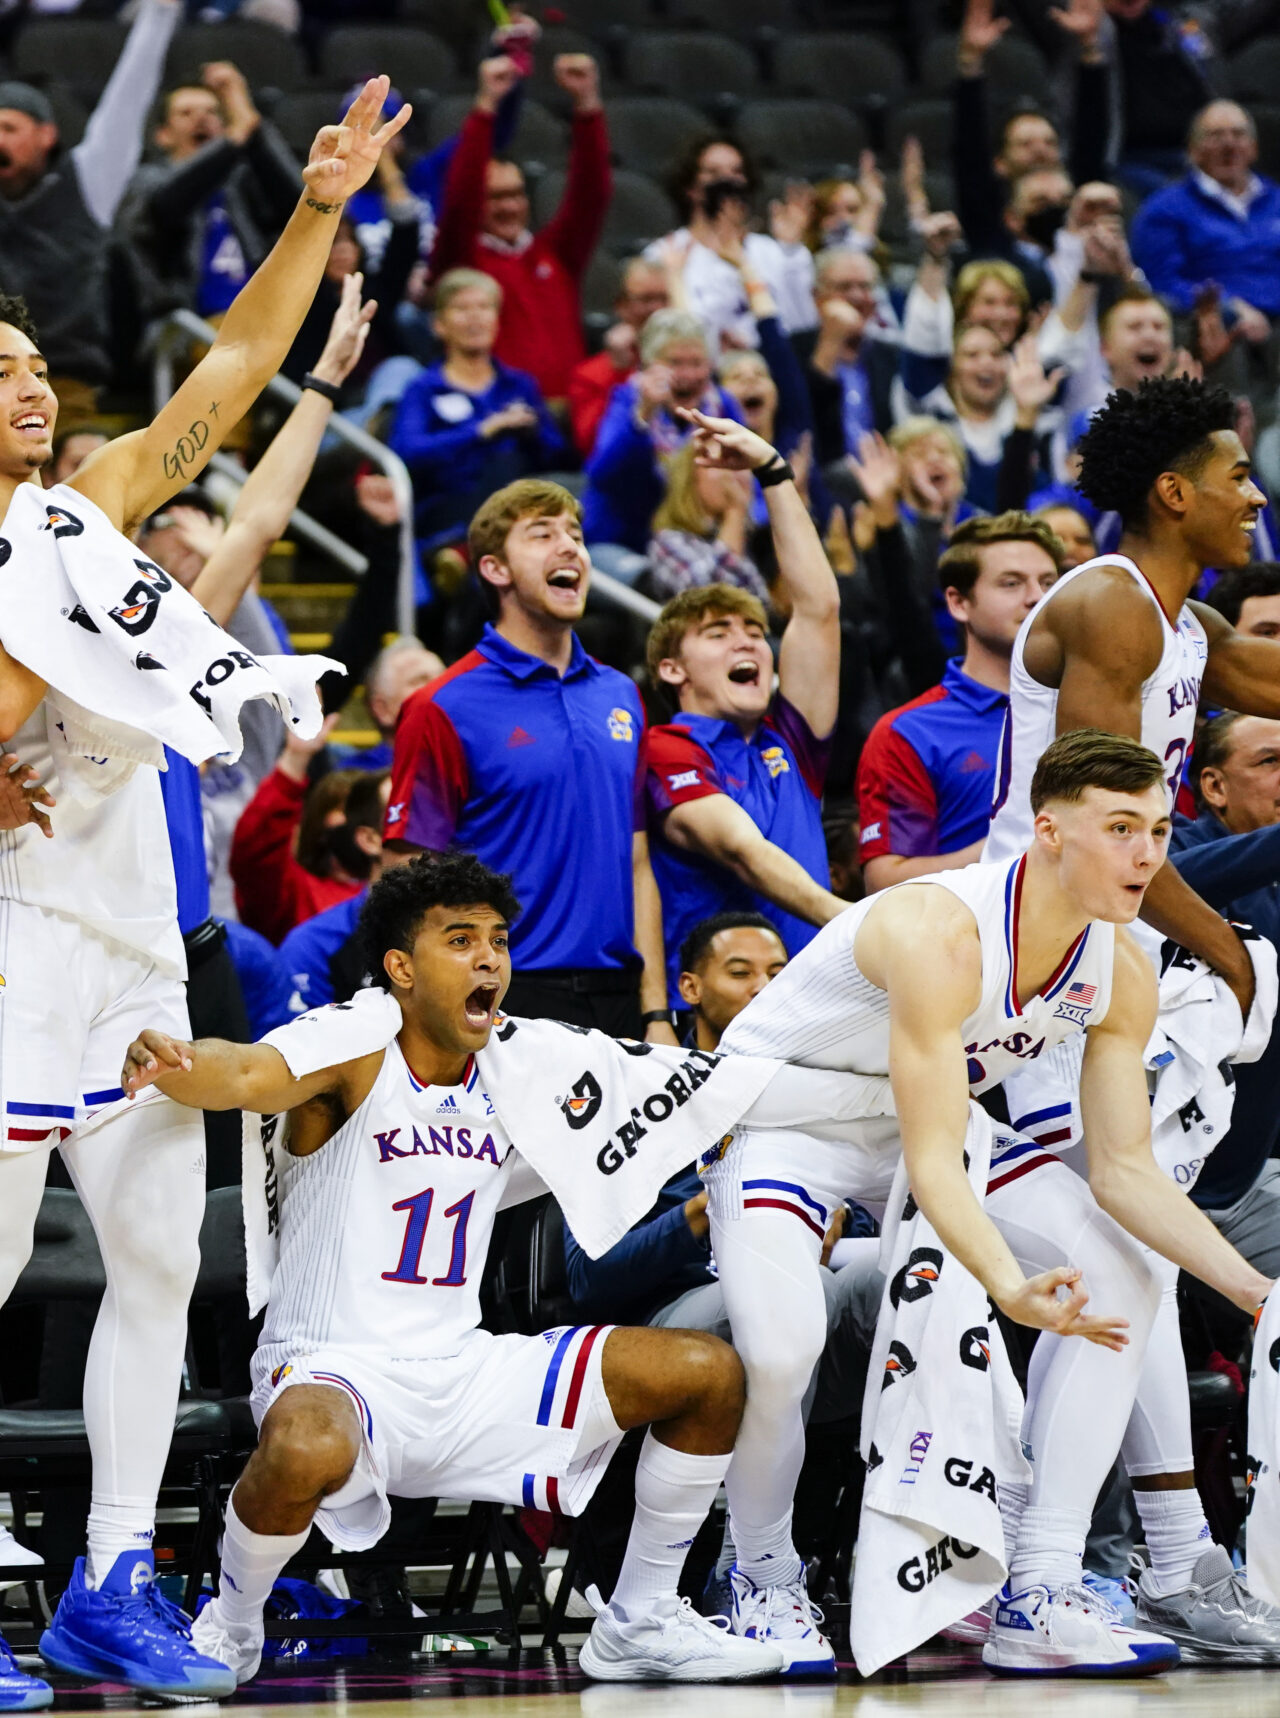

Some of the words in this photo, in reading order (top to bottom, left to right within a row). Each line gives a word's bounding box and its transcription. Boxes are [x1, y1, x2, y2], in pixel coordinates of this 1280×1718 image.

[163, 420, 209, 480] GOD
[435, 1107, 461, 1115] adidas
[380, 1187, 476, 1288] 11
